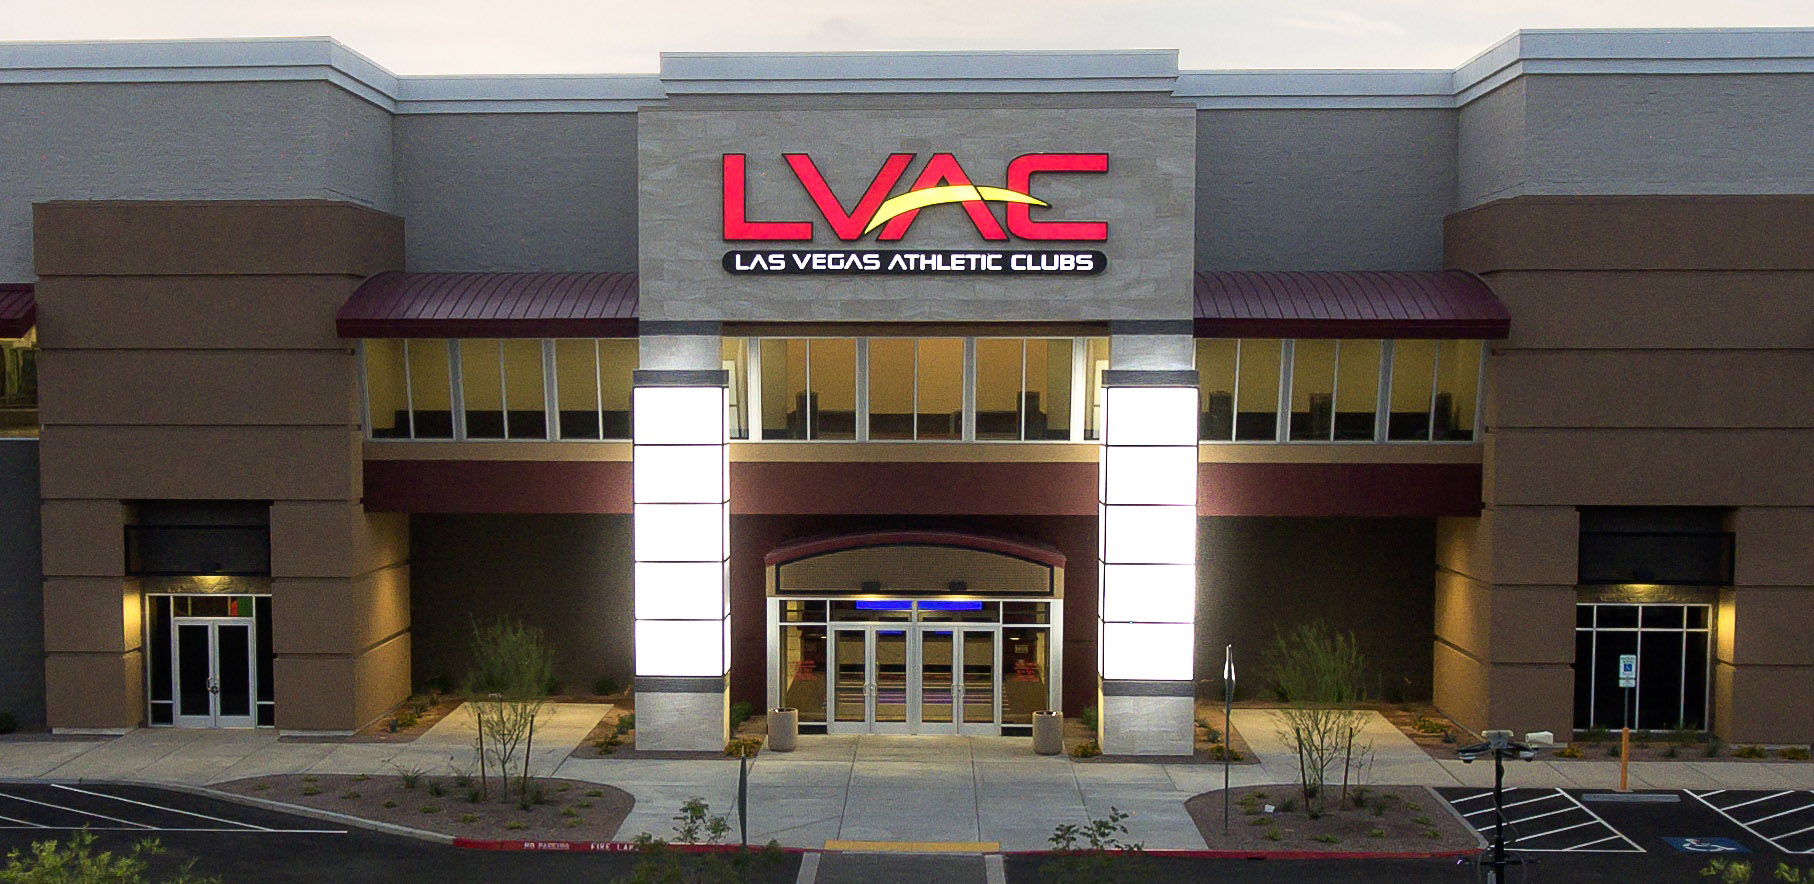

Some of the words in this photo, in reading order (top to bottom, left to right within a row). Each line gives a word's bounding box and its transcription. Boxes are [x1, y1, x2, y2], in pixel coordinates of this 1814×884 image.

[723, 153, 1108, 240] LVAC
[735, 254, 786, 270] LAS
[792, 254, 881, 270] VEGAS
[887, 253, 1003, 271] ATHLETIC
[1011, 254, 1094, 271] CLUBS
[523, 842, 535, 850] NO
[538, 842, 570, 850] PARKING
[590, 842, 611, 851] FIRE
